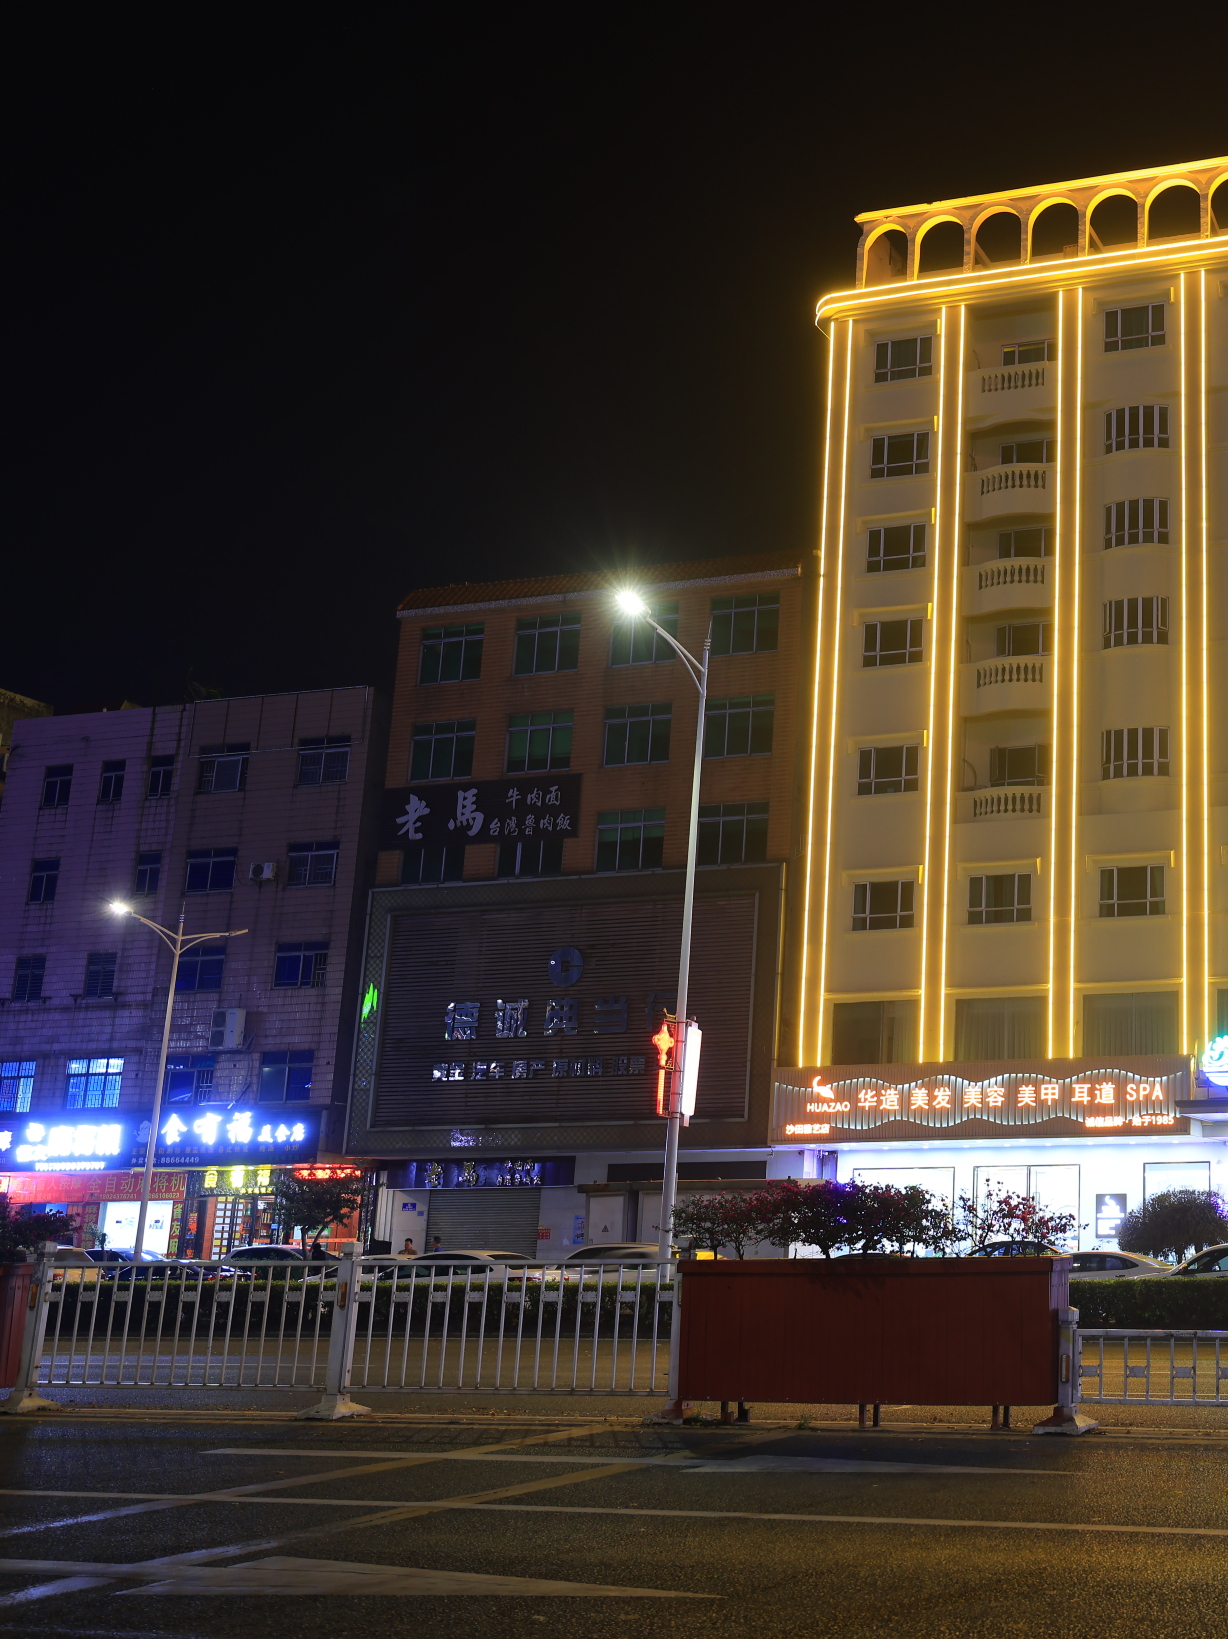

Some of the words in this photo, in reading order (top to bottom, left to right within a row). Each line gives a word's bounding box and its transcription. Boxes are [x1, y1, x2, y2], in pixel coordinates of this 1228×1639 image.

[505, 785, 562, 811] 牛肉面
[395, 788, 485, 841] 老馬
[470, 1060, 505, 1080] 汽车
[511, 1059, 546, 1079] 房产
[551, 1057, 604, 1078] 原材料
[610, 1055, 647, 1076] 股票
[806, 1101, 851, 1113] HUAZAO
[857, 1088, 900, 1110] 华造
[910, 1086, 952, 1110] 美发
[963, 1085, 1006, 1109] 美容
[1017, 1084, 1060, 1107] 美甲
[1071, 1082, 1116, 1105] 耳道
[1125, 1083, 1164, 1101] SPA
